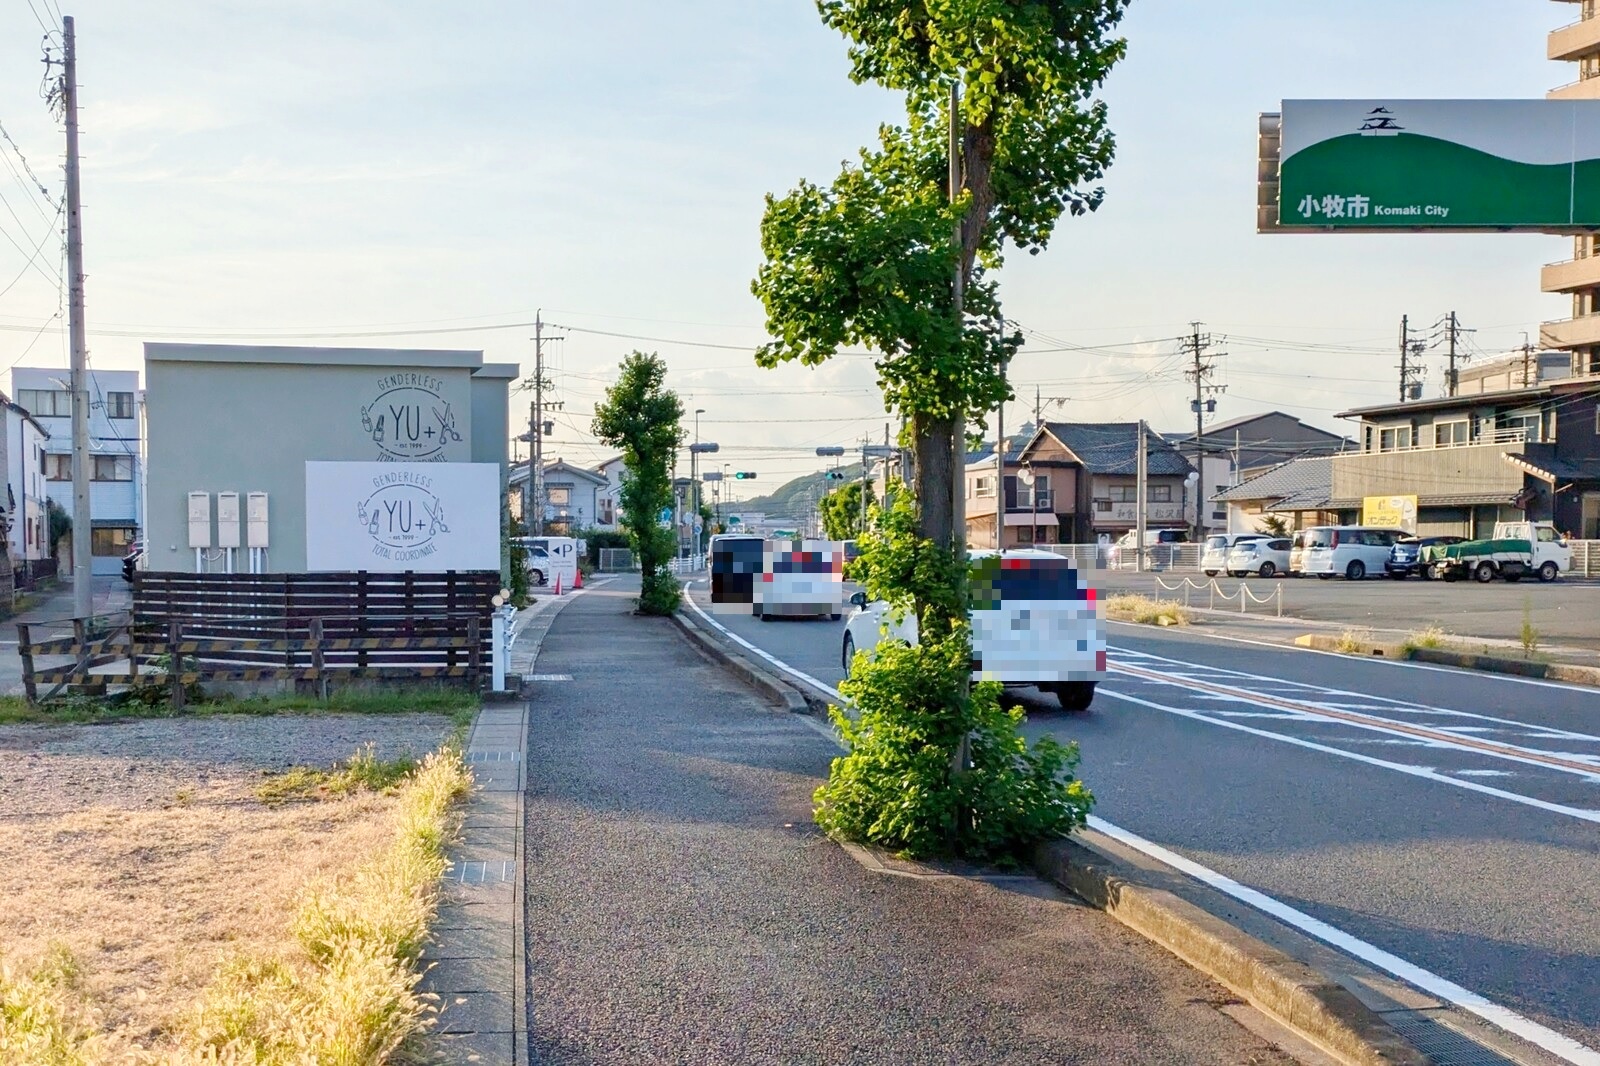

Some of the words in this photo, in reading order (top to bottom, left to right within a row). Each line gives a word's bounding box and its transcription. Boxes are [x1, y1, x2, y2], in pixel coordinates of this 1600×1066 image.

[1297, 194, 1370, 218] 小牧市
[1374, 205, 1421, 215] Komaki
[1424, 205, 1450, 217] City
[377, 373, 443, 391] GENDERLESS
[372, 471, 433, 488] GENDERLESS
[372, 543, 391, 560] TOTAL
[394, 542, 438, 561] COORDINATE
[562, 543, 573, 558] P
